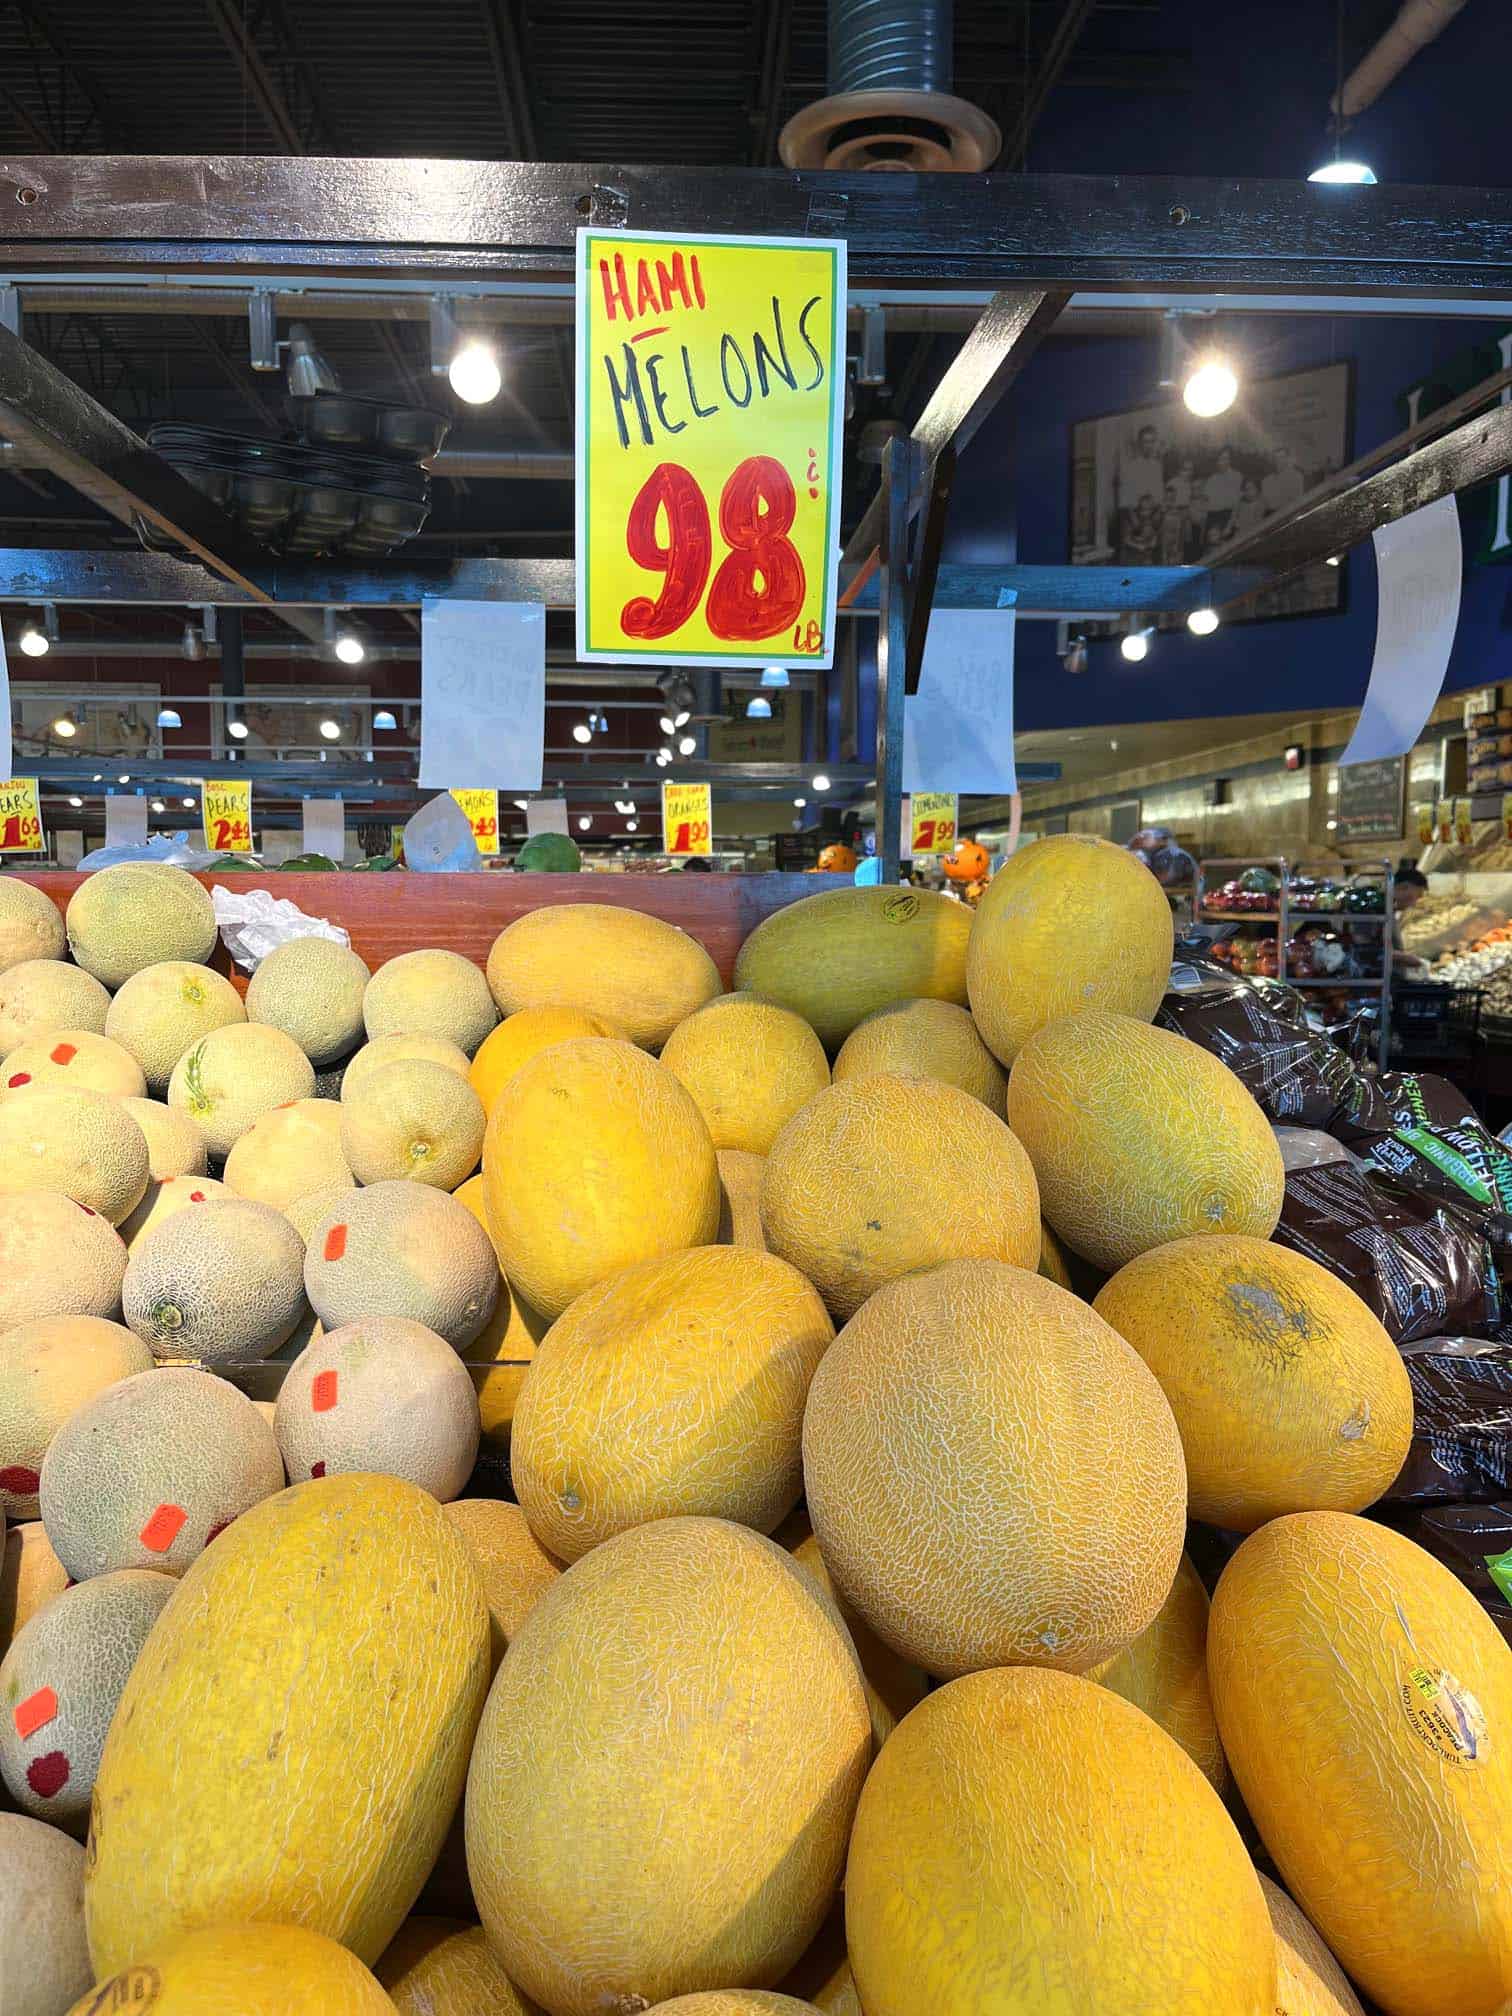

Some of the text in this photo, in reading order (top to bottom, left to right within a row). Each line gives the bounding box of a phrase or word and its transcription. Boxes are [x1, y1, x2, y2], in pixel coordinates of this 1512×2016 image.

[599, 251, 706, 321] HAMI
[604, 295, 825, 449] MELONS
[0, 790, 33, 813] EARS
[206, 792, 249, 818] PEARS
[1423, 1142, 1479, 1186] ORGANIC
